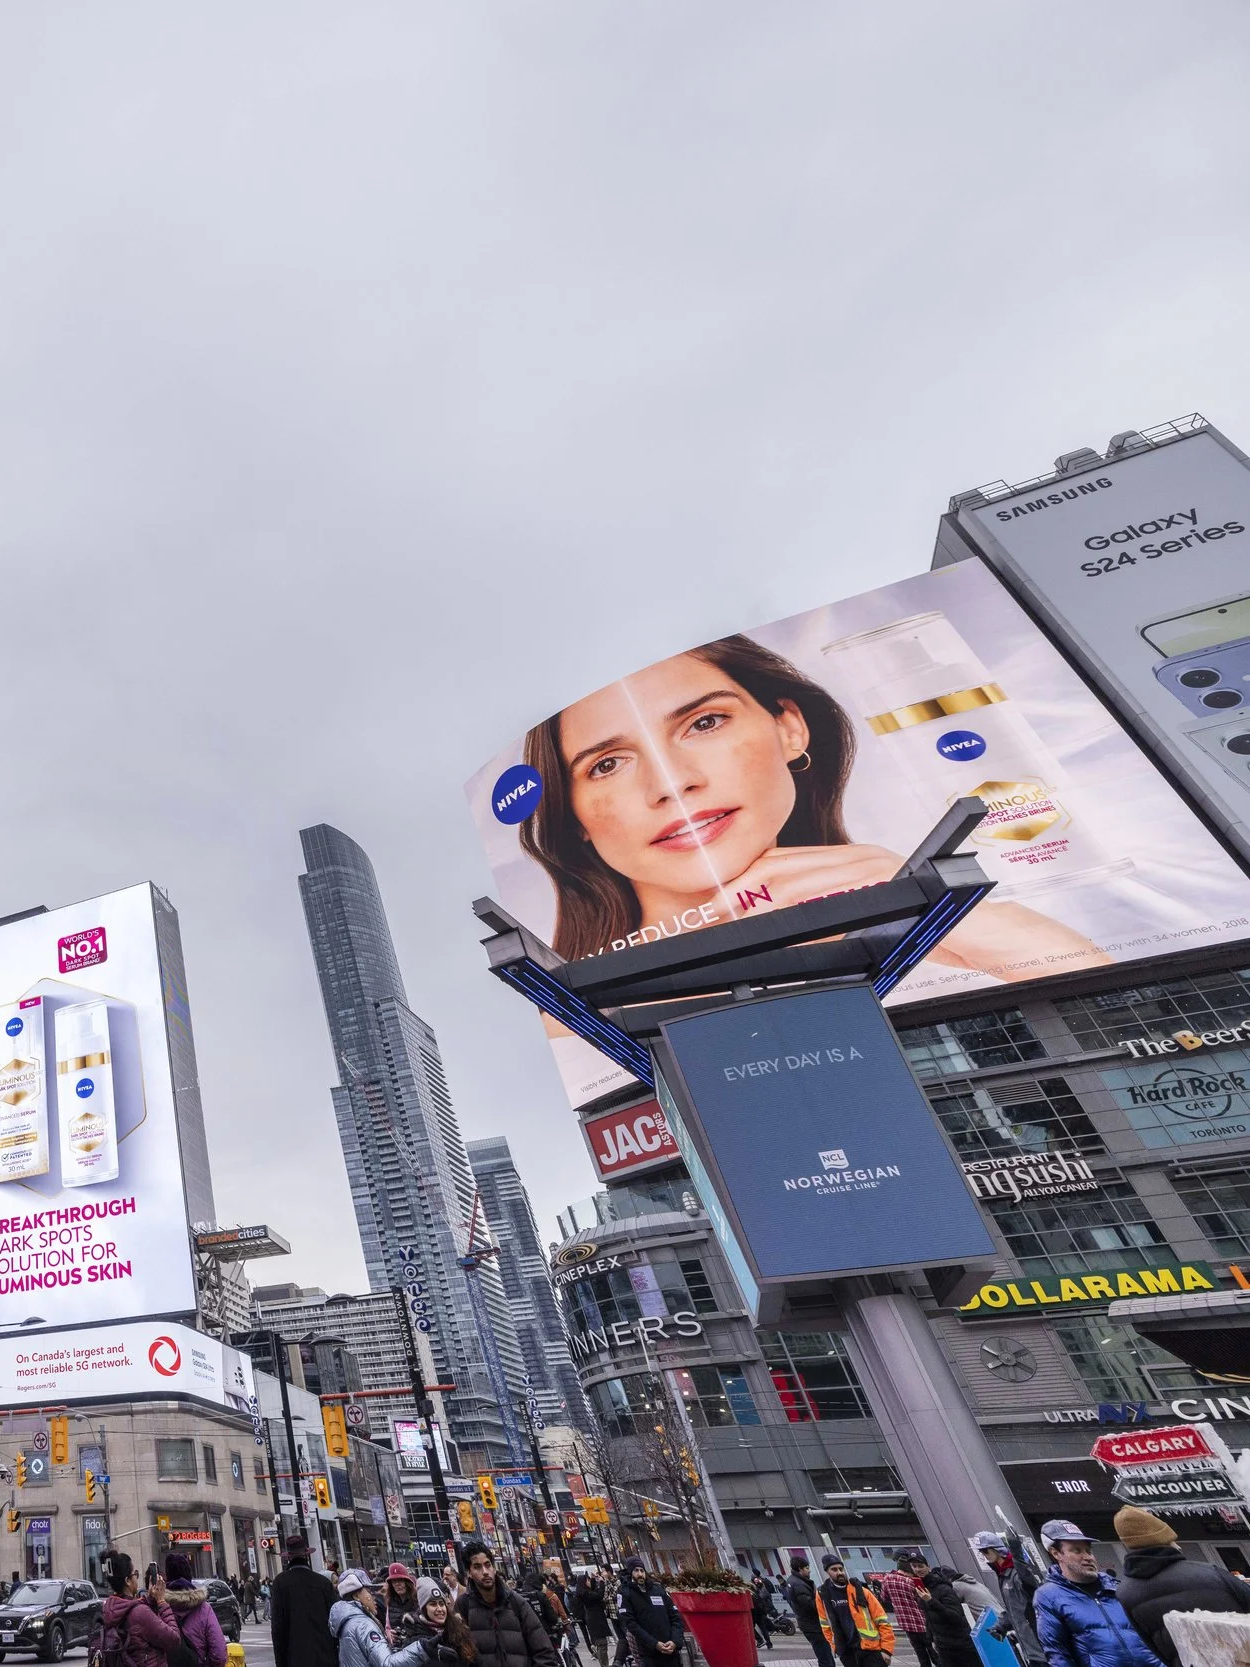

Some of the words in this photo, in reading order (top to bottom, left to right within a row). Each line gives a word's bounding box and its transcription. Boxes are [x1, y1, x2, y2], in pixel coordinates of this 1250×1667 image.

[996, 477, 1114, 522] SAMSUNG
[1084, 508, 1200, 551] Galaxy
[1080, 551, 1137, 578] S24
[1139, 520, 1245, 560] Series
[941, 738, 981, 754] NIVEA
[496, 778, 537, 812] NIVEA
[987, 810, 1009, 820] SPOT
[999, 813, 1028, 823] TACHES
[1000, 846, 1041, 859] ADVANCED
[1041, 840, 1070, 850] SERUM
[736, 884, 773, 911] IN
[64, 930, 100, 945] WORLD'S
[61, 936, 105, 962] NO.1
[939, 964, 1003, 986] Self-grading
[1044, 949, 1090, 965] 12-week
[1090, 943, 1123, 958] study
[1125, 936, 1152, 949] with
[1154, 933, 1170, 944] 34
[1173, 926, 1222, 940] women,
[1224, 917, 1250, 929] 2018
[65, 957, 84, 967] DARK
[85, 953, 100, 962] SPOT
[65, 962, 84, 971] SERUM
[7, 1023, 22, 1031] NIVEA
[1118, 1037, 1179, 1060] The
[1172, 1026, 1242, 1051] Beer
[724, 1060, 779, 1082] EVERY
[786, 1051, 822, 1071] DAY
[826, 1047, 846, 1064] IS
[849, 1044, 864, 1061] A
[77, 1084, 92, 1092] NIVEA
[580, 1081, 598, 1093] Visibly
[598, 1071, 623, 1085] reduces
[1127, 1078, 1188, 1104] Hard
[1188, 1072, 1246, 1098] Rock
[20, 1110, 37, 1118] SERUM
[1184, 1100, 1216, 1112] CAFE
[1190, 1124, 1247, 1139] TORONTO
[822, 1152, 845, 1165] NCL
[961, 1152, 1050, 1173] RESTAURANT
[784, 1165, 901, 1192] NORWEGIAN
[816, 1184, 852, 1195] CRUISE
[40, 1225, 93, 1248] SPOTS
[199, 1228, 265, 1244] brandedcities
[82, 1241, 118, 1261] FOR
[88, 1260, 132, 1283] SKIN
[555, 1255, 621, 1287] CINEPLEX
[395, 1293, 413, 1356] DOWNTOWN
[16, 1354, 29, 1364] On
[31, 1349, 71, 1363] Canada's
[73, 1346, 107, 1360] largest
[109, 1343, 125, 1353] and
[16, 1367, 39, 1377] most
[40, 1363, 74, 1375] reliable
[76, 1361, 89, 1372] 5G
[91, 1356, 133, 1369] network.
[1112, 1436, 1197, 1457] CALGARY
[1051, 1480, 1091, 1494] ENOR
[1125, 1479, 1227, 1497] VANCOUVER
[85, 1519, 101, 1529] fido
[181, 1532, 211, 1540] ROGERS
